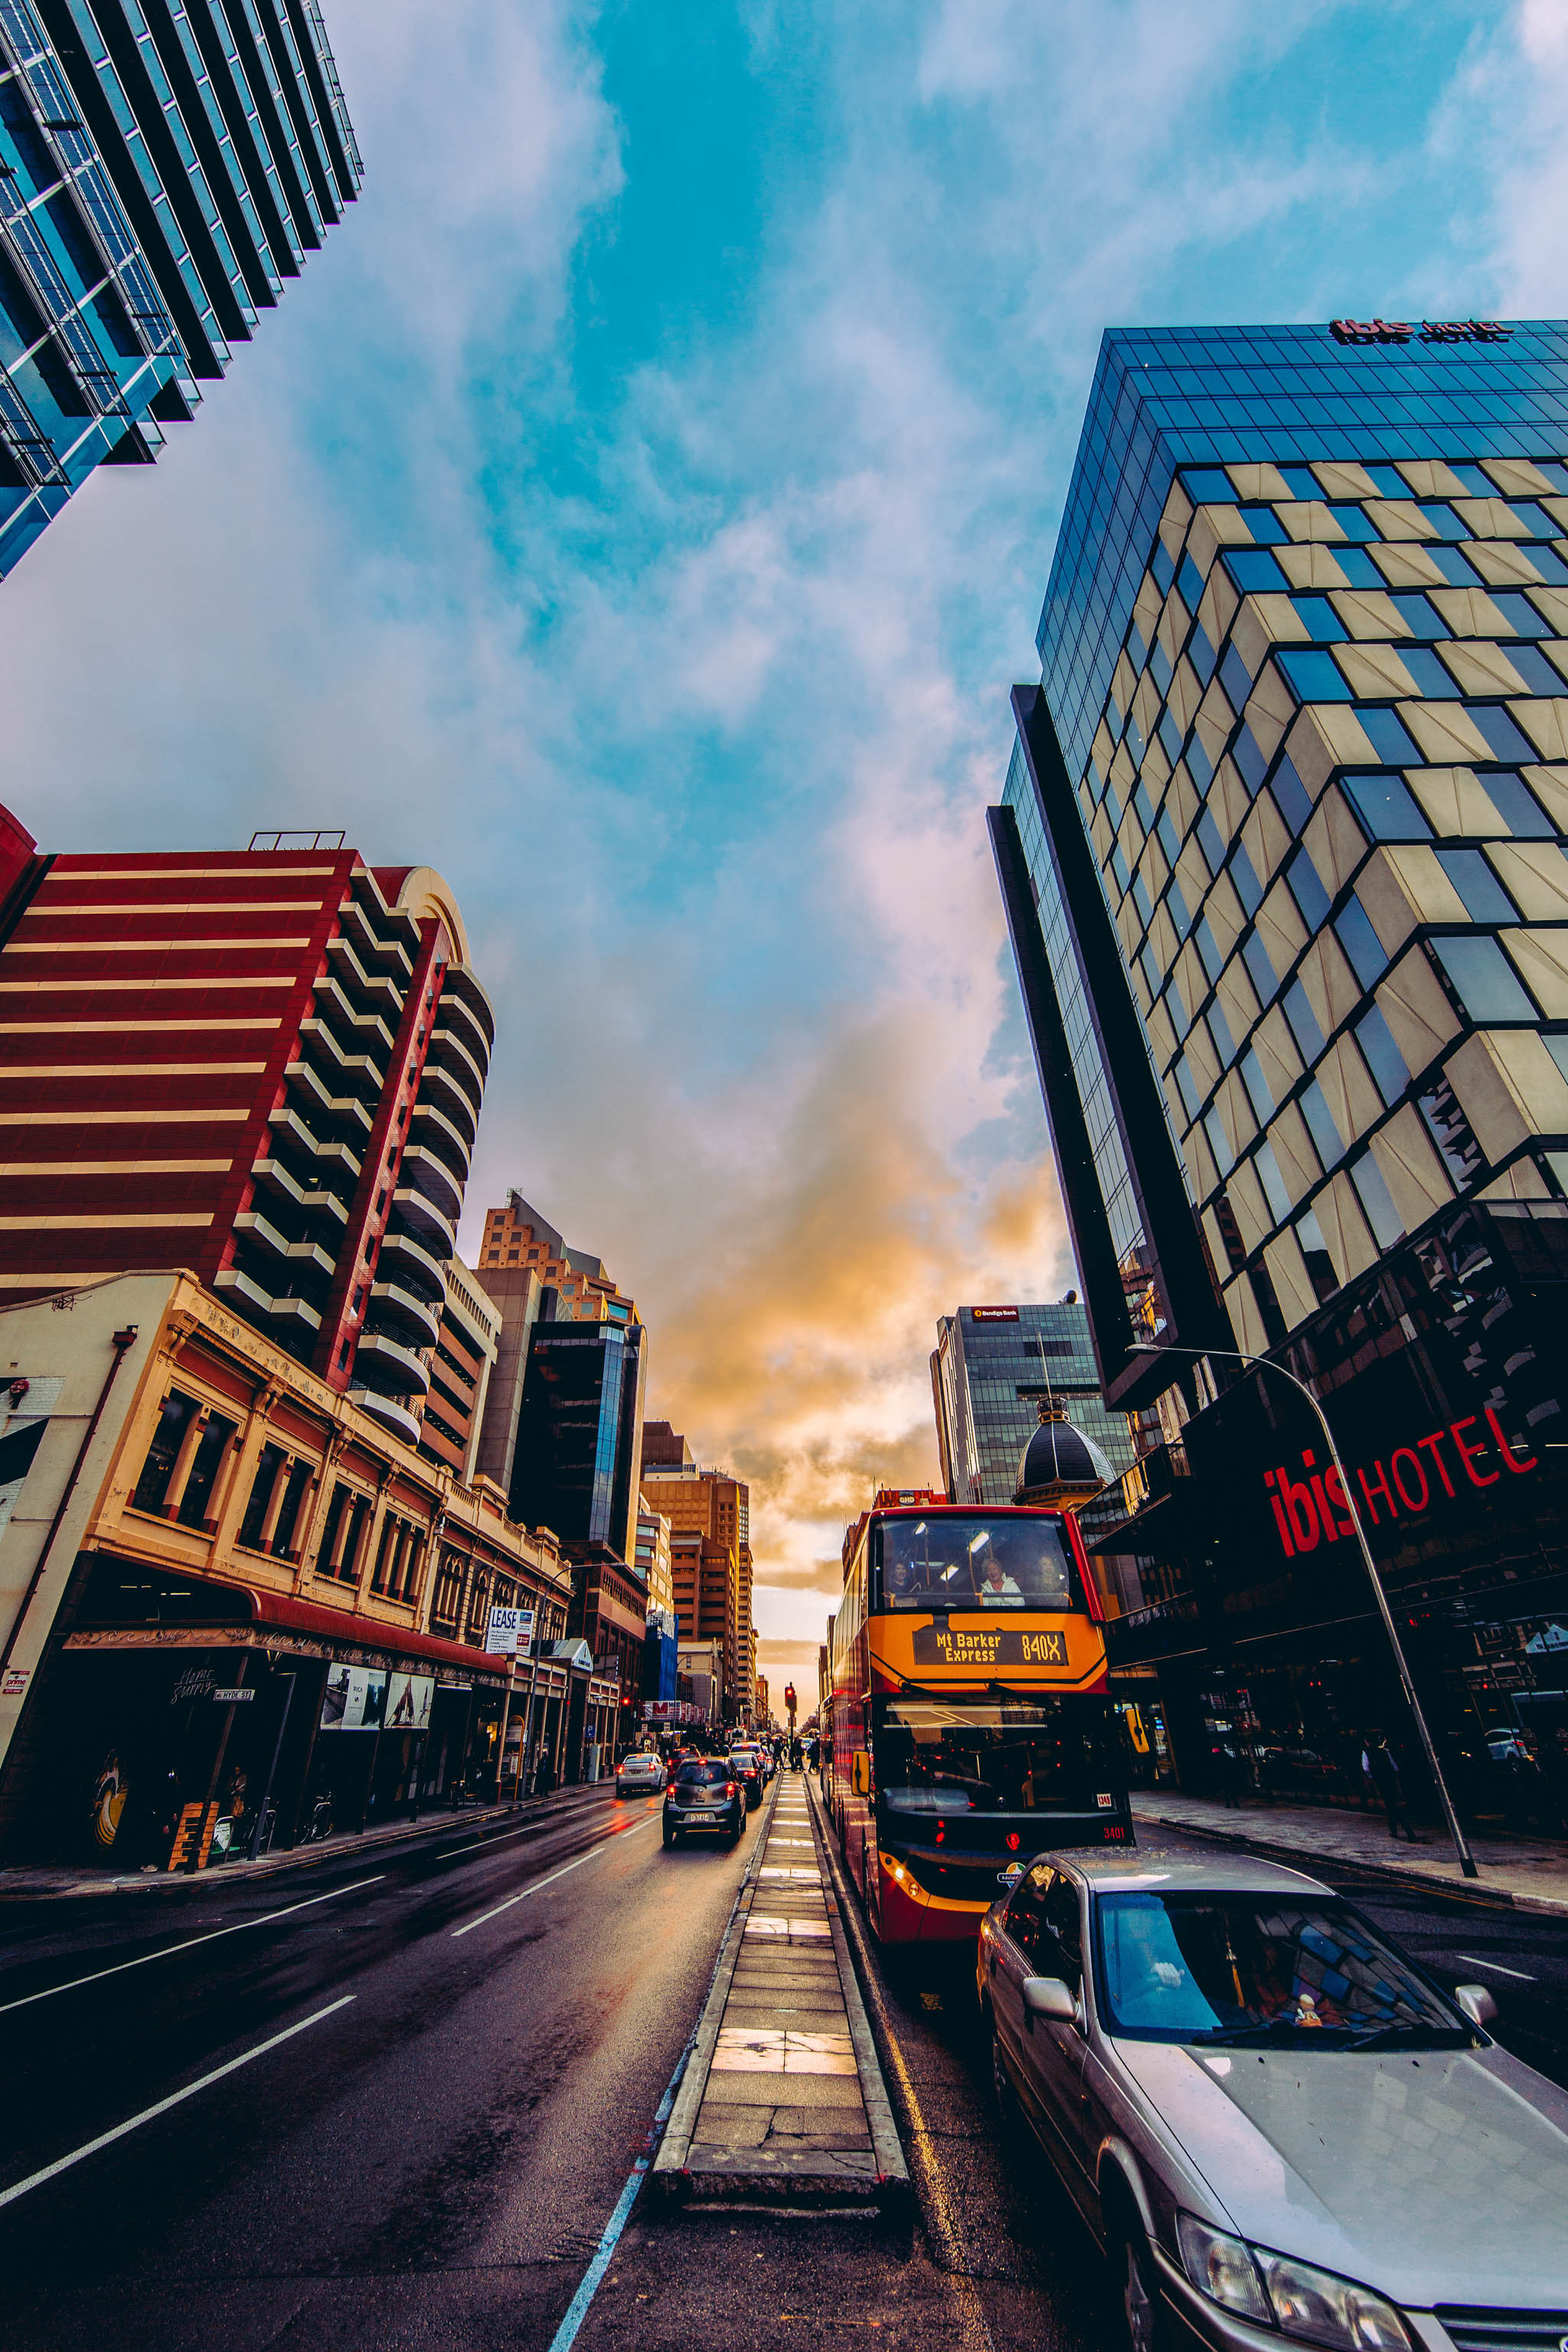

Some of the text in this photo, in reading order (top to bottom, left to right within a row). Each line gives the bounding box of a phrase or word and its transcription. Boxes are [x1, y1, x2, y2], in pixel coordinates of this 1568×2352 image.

[1331, 318, 1514, 335] ibis HOTEL
[1263, 1408, 1538, 1557] ibis HOTEL
[492, 1609, 518, 1629] LEASE
[936, 1633, 1001, 1648] Mt Barker
[1021, 1635, 1061, 1661] 840X
[945, 1648, 995, 1662] Express
[1103, 1827, 1125, 1839] 3401
